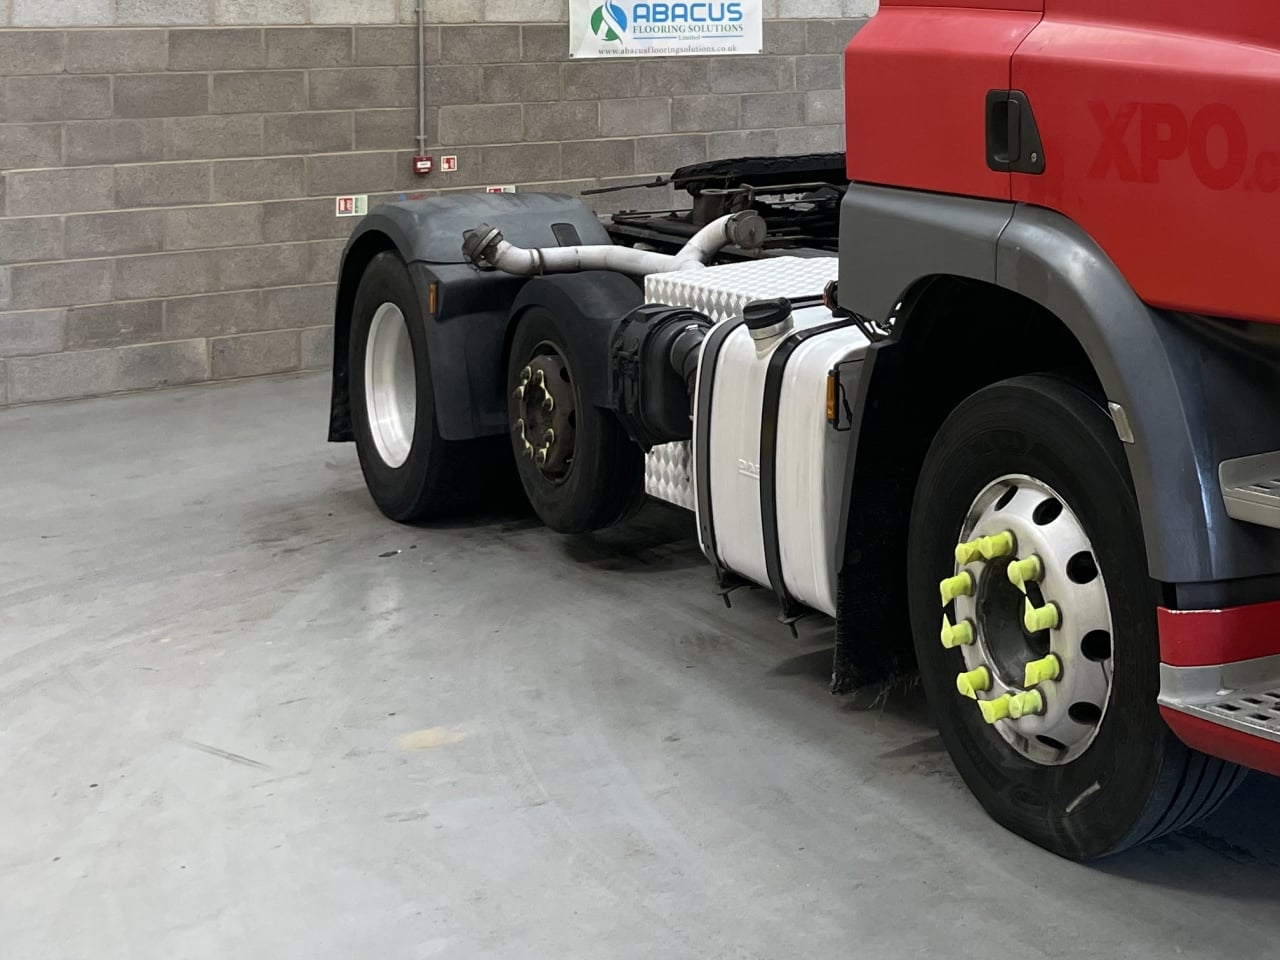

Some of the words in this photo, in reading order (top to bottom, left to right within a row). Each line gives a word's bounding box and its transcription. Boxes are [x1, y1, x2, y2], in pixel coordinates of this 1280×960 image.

[632, 3, 744, 23] ABACUS
[633, 25, 686, 34] FLOORING
[688, 24, 744, 33] SOLUTIONS
